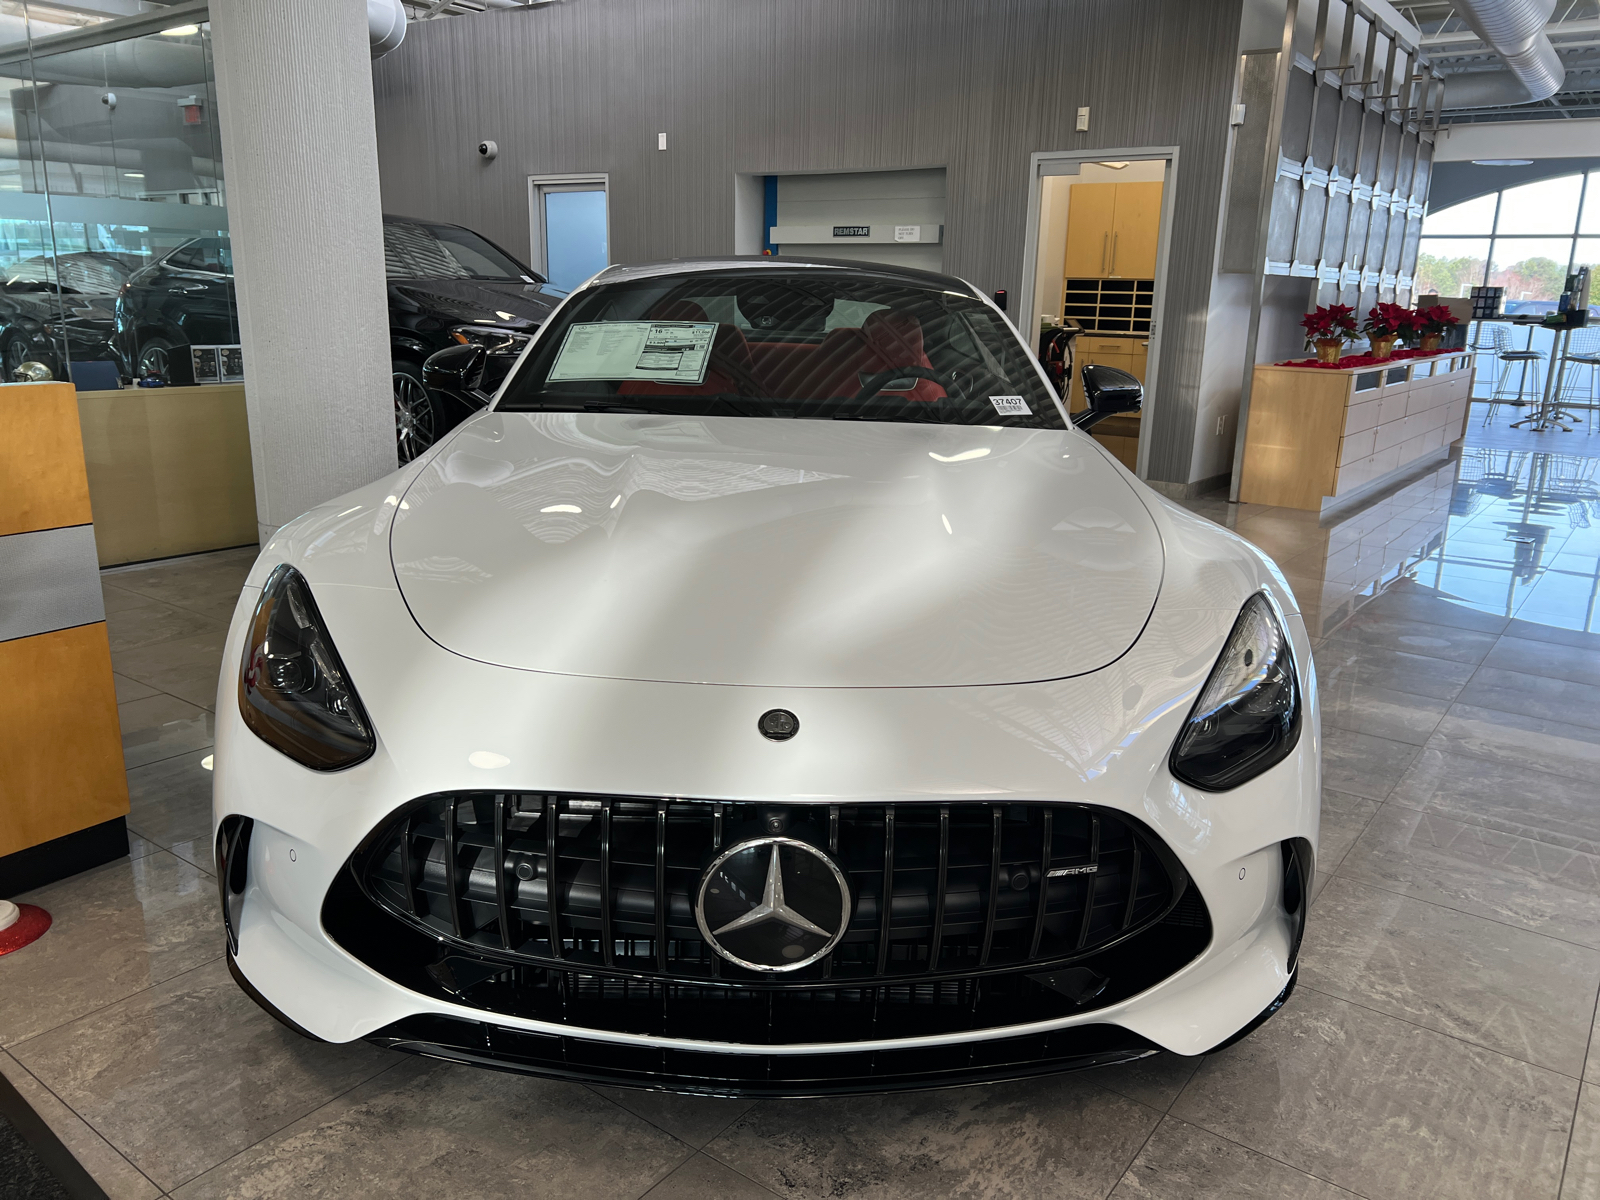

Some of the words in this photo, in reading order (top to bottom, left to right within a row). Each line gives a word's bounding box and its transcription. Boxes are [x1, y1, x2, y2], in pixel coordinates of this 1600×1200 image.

[834, 227, 868, 236] REMSTAR
[993, 398, 1022, 406] 37407
[1062, 865, 1098, 876] AMG
